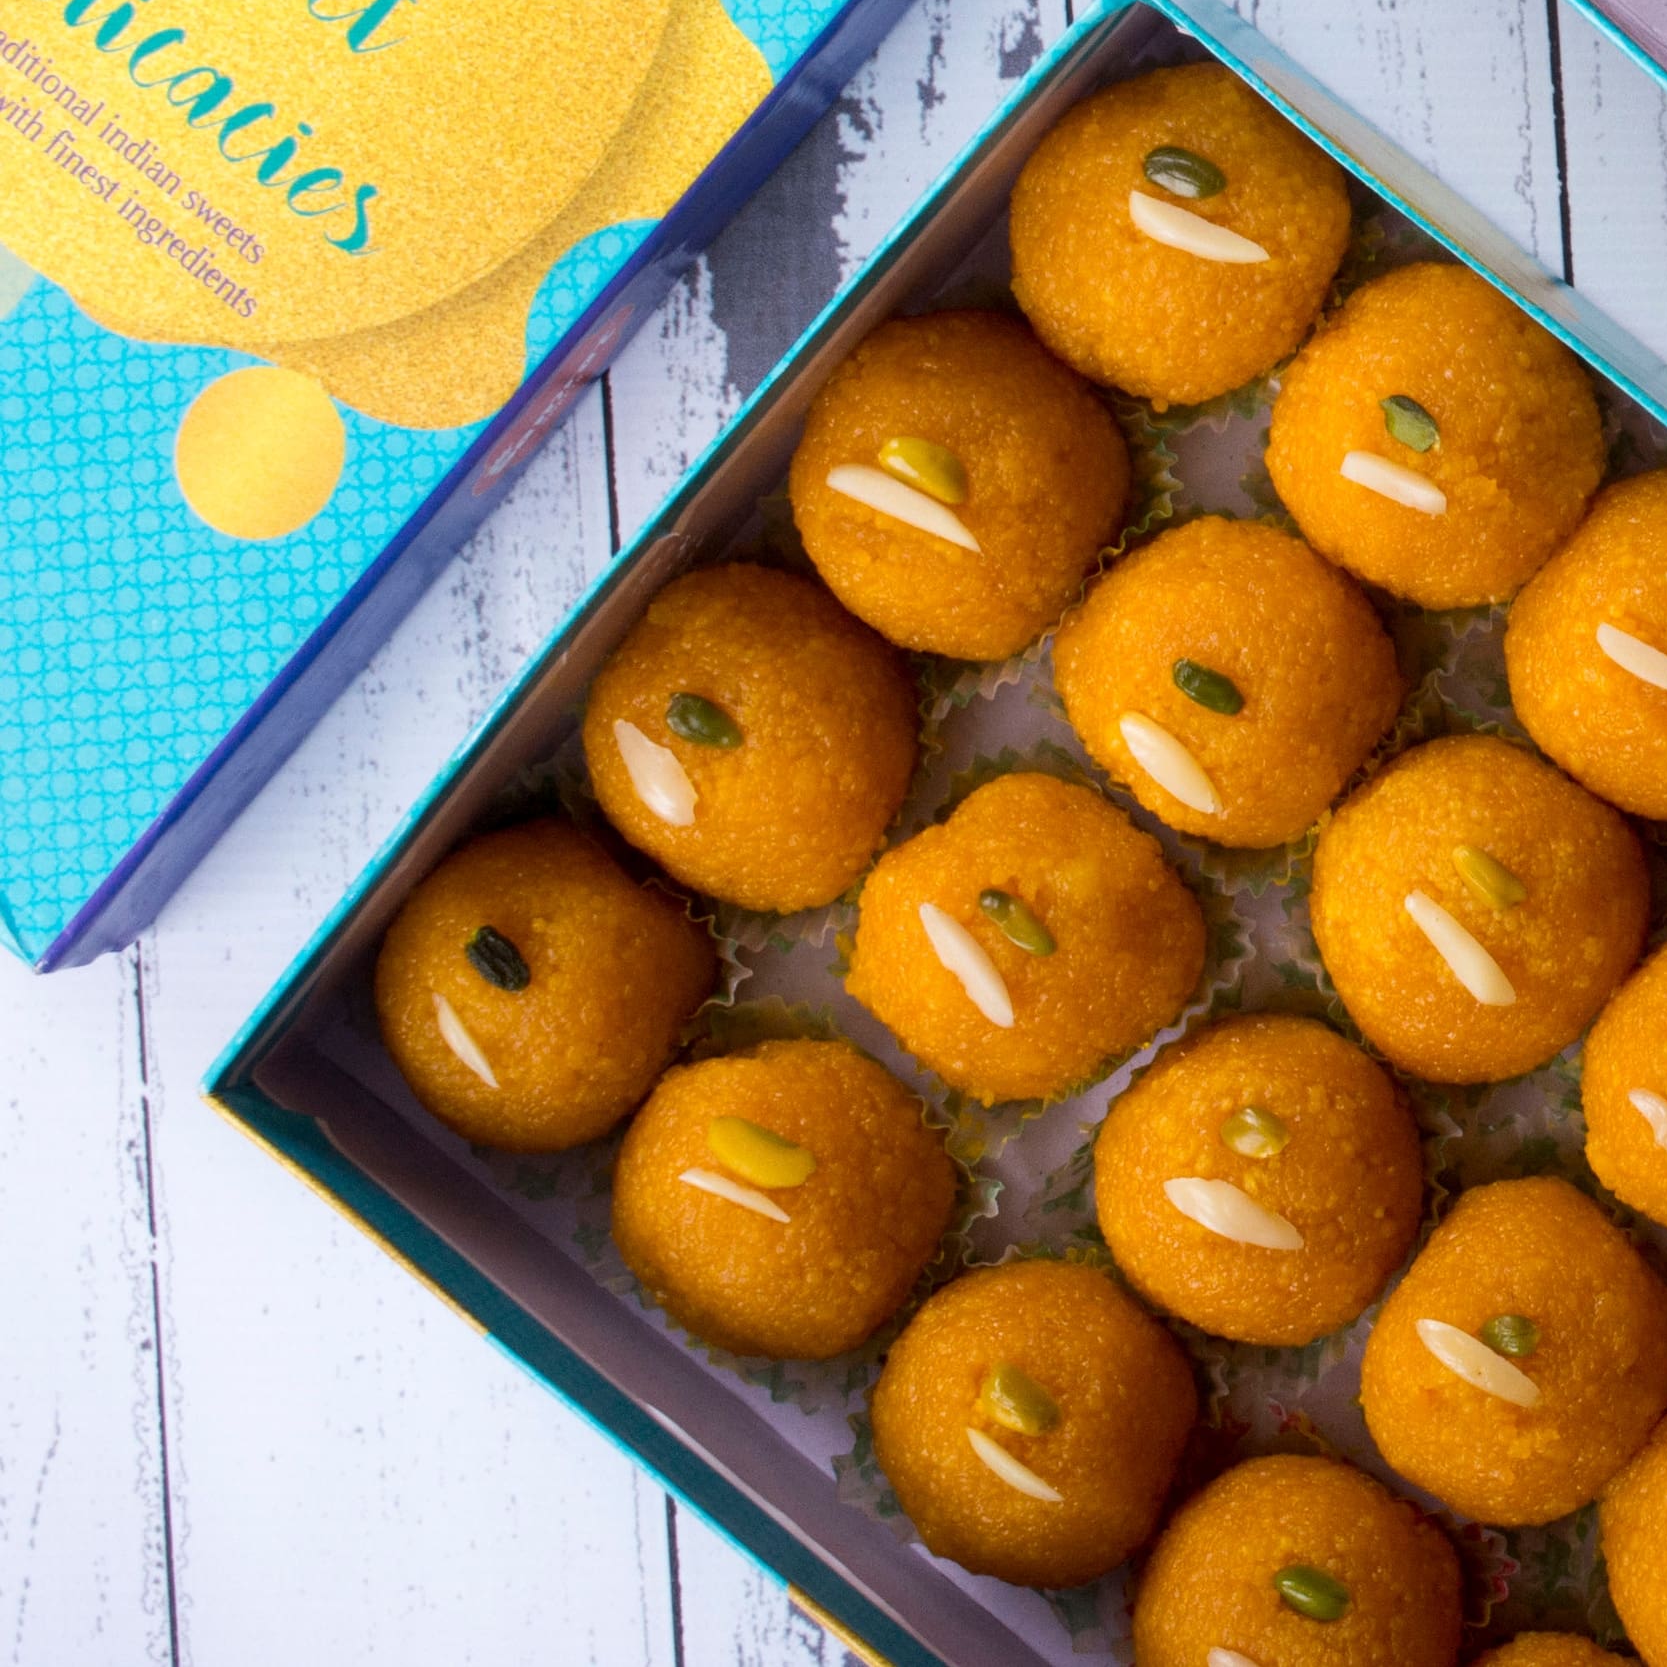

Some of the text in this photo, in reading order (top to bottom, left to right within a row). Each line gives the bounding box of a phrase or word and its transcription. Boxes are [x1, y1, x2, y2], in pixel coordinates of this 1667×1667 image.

[43, 129, 120, 203] finest
[116, 189, 258, 318] ingredients
[97, 113, 182, 196] indian
[181, 190, 265, 265] sweets
